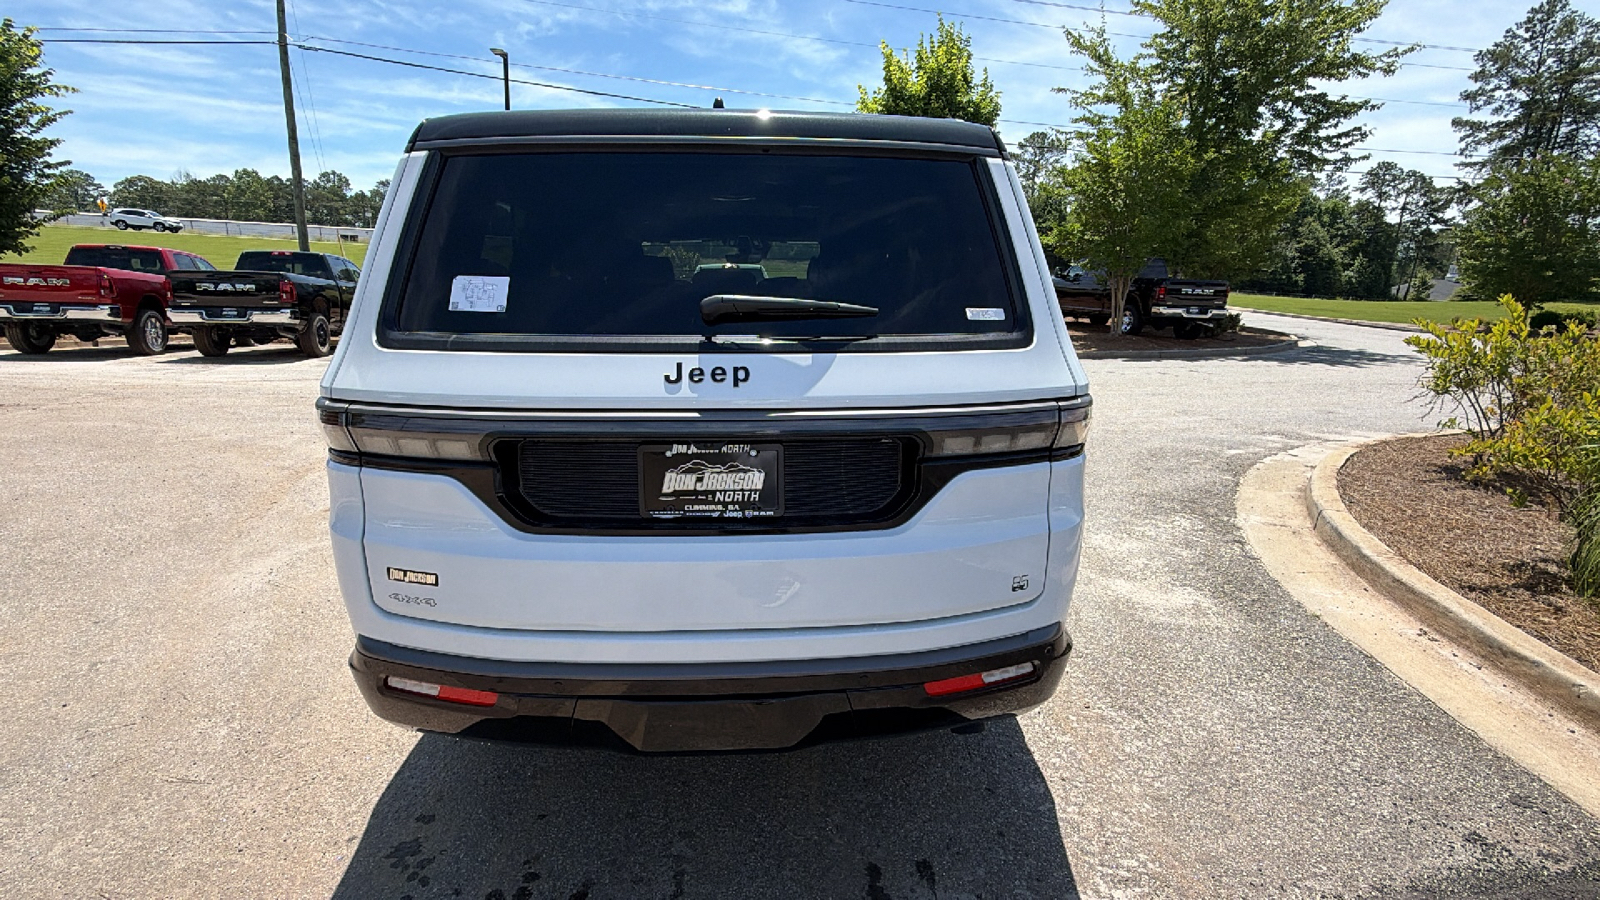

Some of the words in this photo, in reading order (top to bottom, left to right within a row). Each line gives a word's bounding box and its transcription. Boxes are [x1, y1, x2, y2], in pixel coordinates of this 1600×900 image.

[3, 276, 71, 287] RAM
[195, 282, 256, 292] RAM
[663, 361, 751, 388] Jeep
[721, 444, 751, 454] NORTH
[714, 491, 760, 502] NORTH
[723, 510, 743, 518] Jeep
